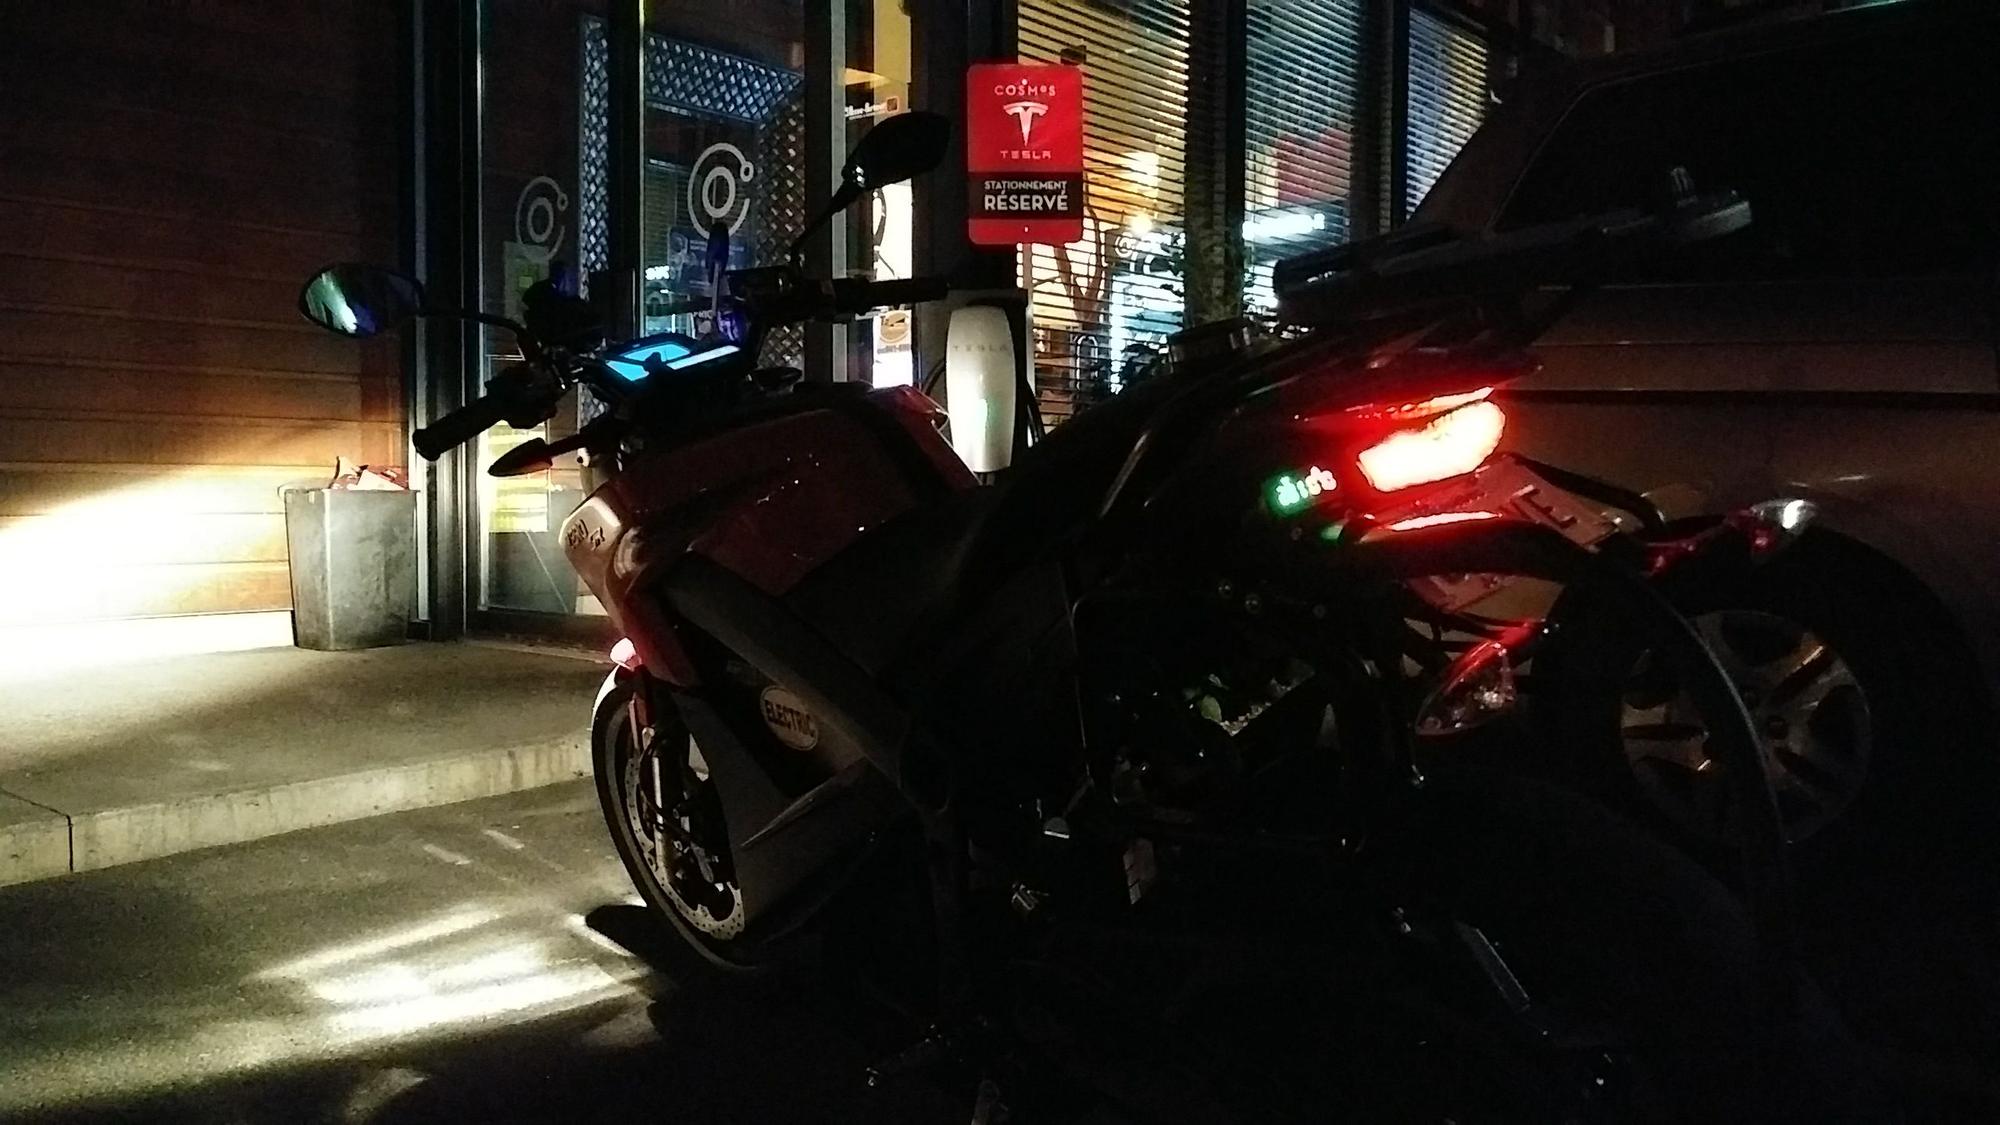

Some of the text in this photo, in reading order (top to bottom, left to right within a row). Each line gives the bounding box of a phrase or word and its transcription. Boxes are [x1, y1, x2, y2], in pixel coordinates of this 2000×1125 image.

[1000, 150, 1052, 160] TESLA
[984, 180, 1068, 191] STATIONNEMENT
[984, 189, 1069, 211] RÉSERVÉ
[764, 699, 815, 738] ELECTRIC
